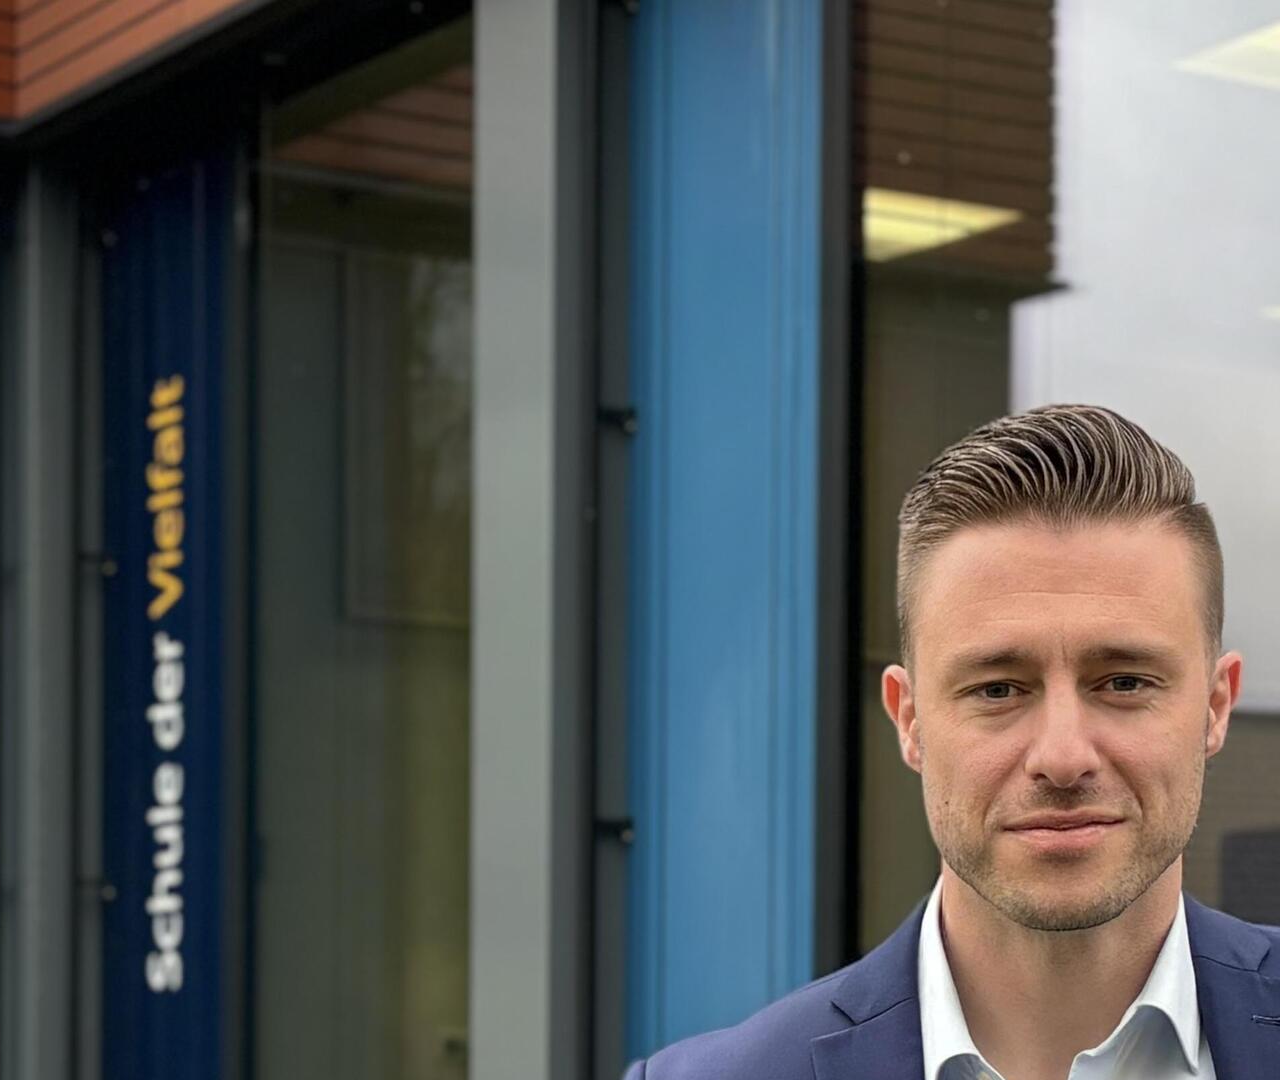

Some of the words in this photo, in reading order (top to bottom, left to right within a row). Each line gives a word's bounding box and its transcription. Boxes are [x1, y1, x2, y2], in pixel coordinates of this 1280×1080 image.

[146, 374, 185, 620] Vielfalt
[146, 631, 184, 752] der
[145, 761, 184, 993] Schule
